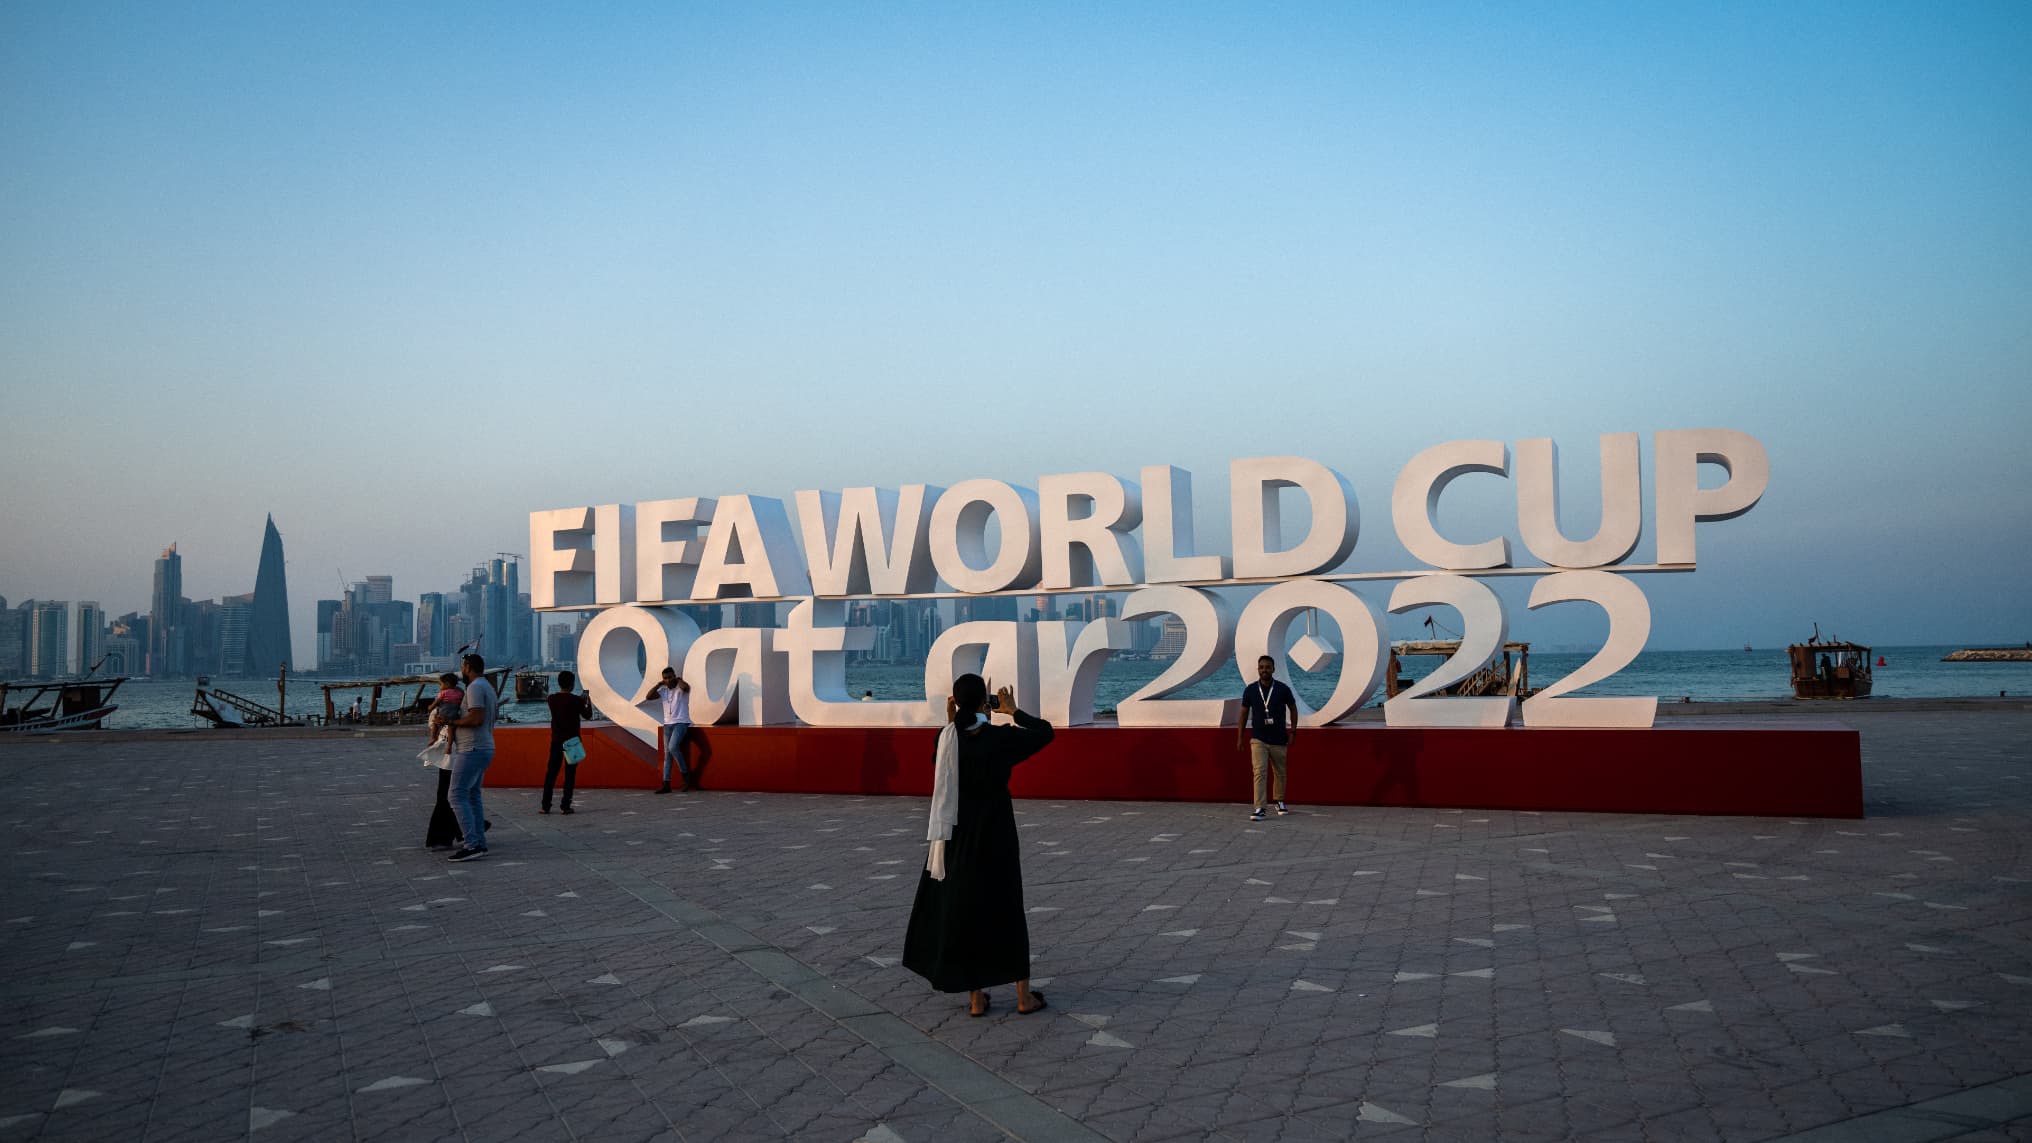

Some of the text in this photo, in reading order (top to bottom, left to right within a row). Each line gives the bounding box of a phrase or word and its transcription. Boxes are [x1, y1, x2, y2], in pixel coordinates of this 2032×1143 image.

[529, 428, 1770, 609] FIFA WORLD CUP
[577, 570, 1658, 751] Qatar 2022
